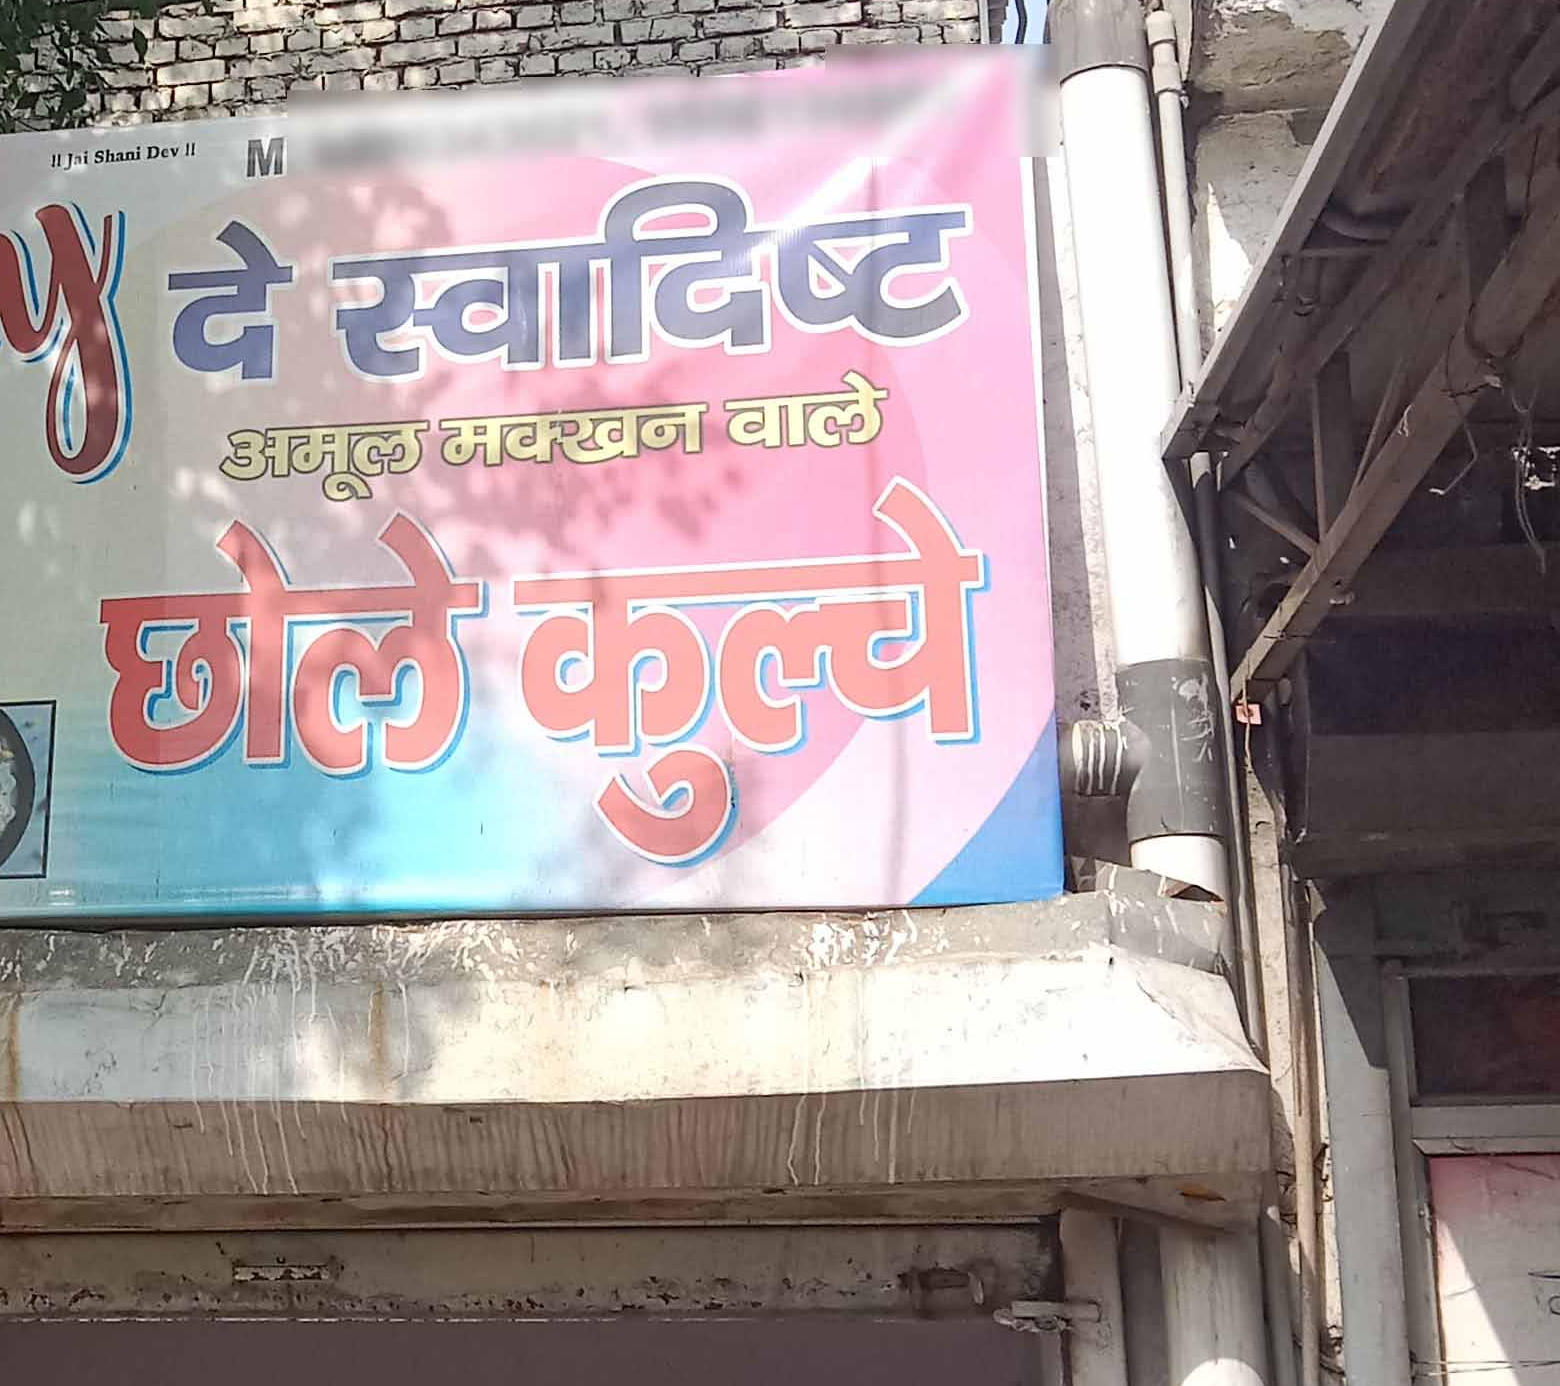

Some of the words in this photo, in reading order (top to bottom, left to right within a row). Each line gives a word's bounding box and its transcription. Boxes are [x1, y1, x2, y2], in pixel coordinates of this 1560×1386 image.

[93, 146, 141, 164] Shani
[146, 146, 179, 160] Dev
[328, 179, 974, 381] स्वादिष्ट
[220, 418, 428, 501] अमूल
[440, 399, 706, 469] मक्खन
[724, 371, 888, 451] वाले
[100, 509, 490, 778] छोले
